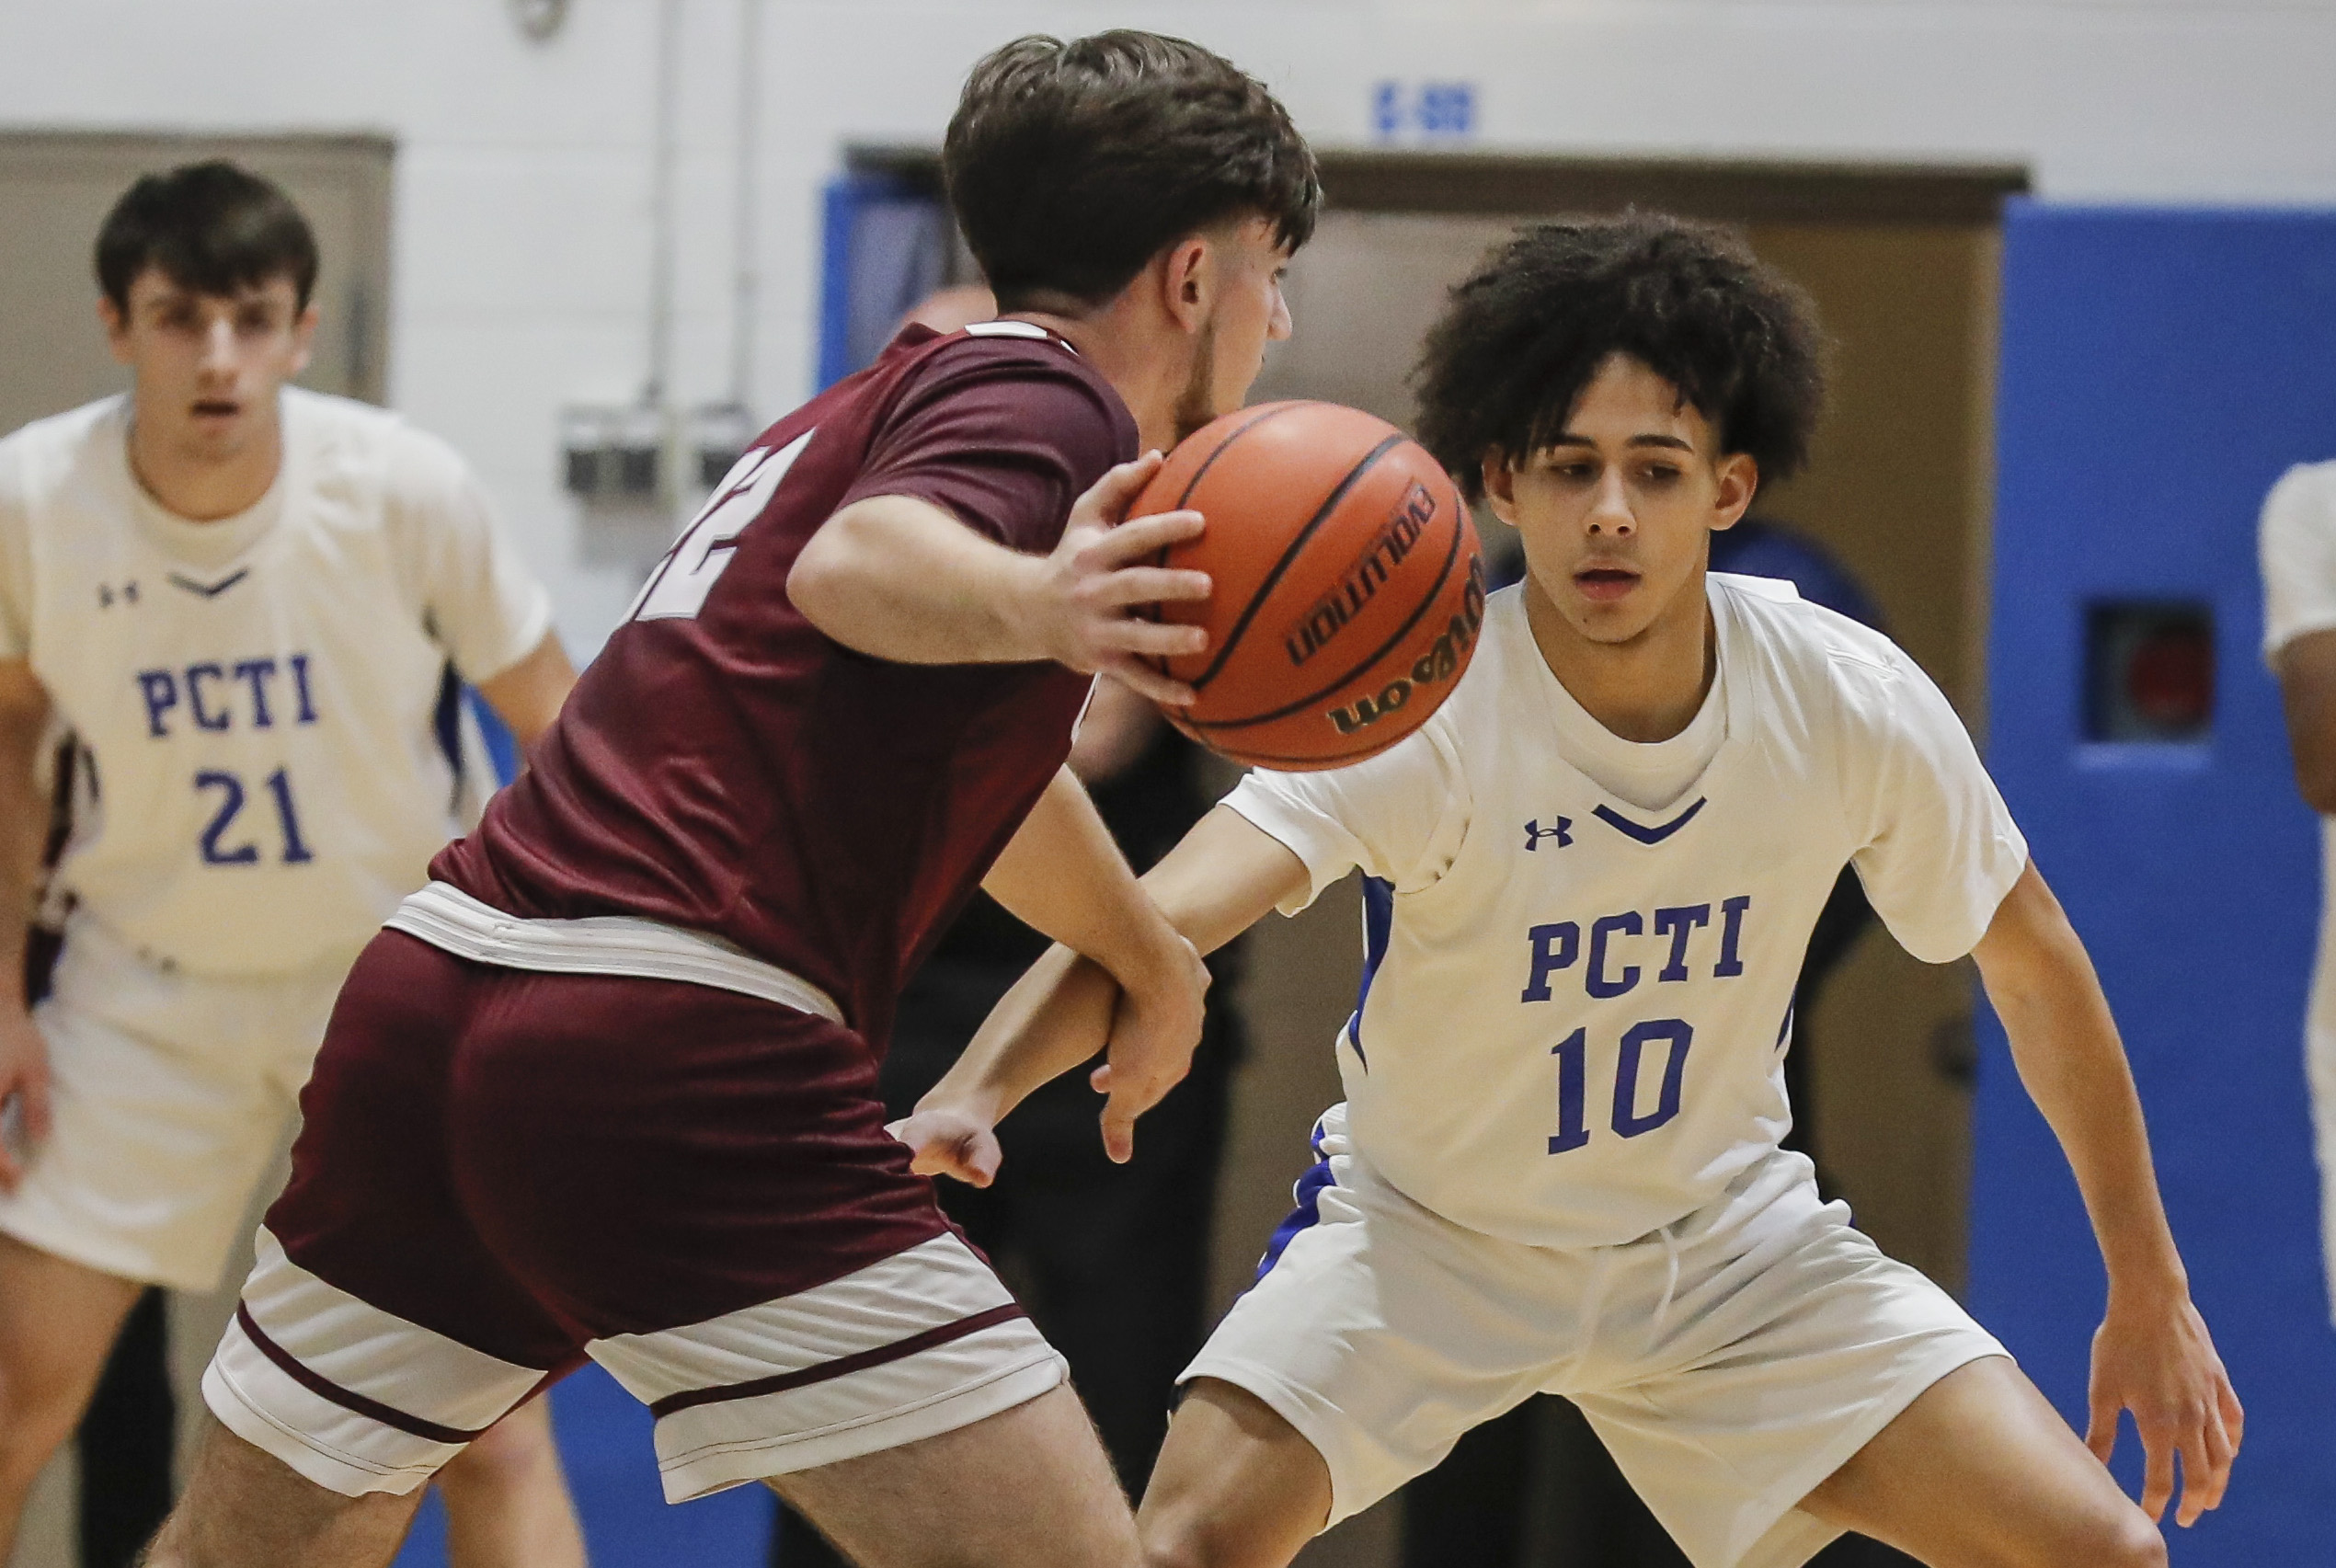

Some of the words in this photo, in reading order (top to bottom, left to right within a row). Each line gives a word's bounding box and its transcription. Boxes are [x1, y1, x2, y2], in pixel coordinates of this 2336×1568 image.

[1286, 477, 1437, 667] EVOLUTION
[135, 653, 319, 738] PCTI
[193, 769, 315, 865] 21
[1520, 895, 1751, 1003] PCTI
[1548, 1017, 1694, 1156] 10
